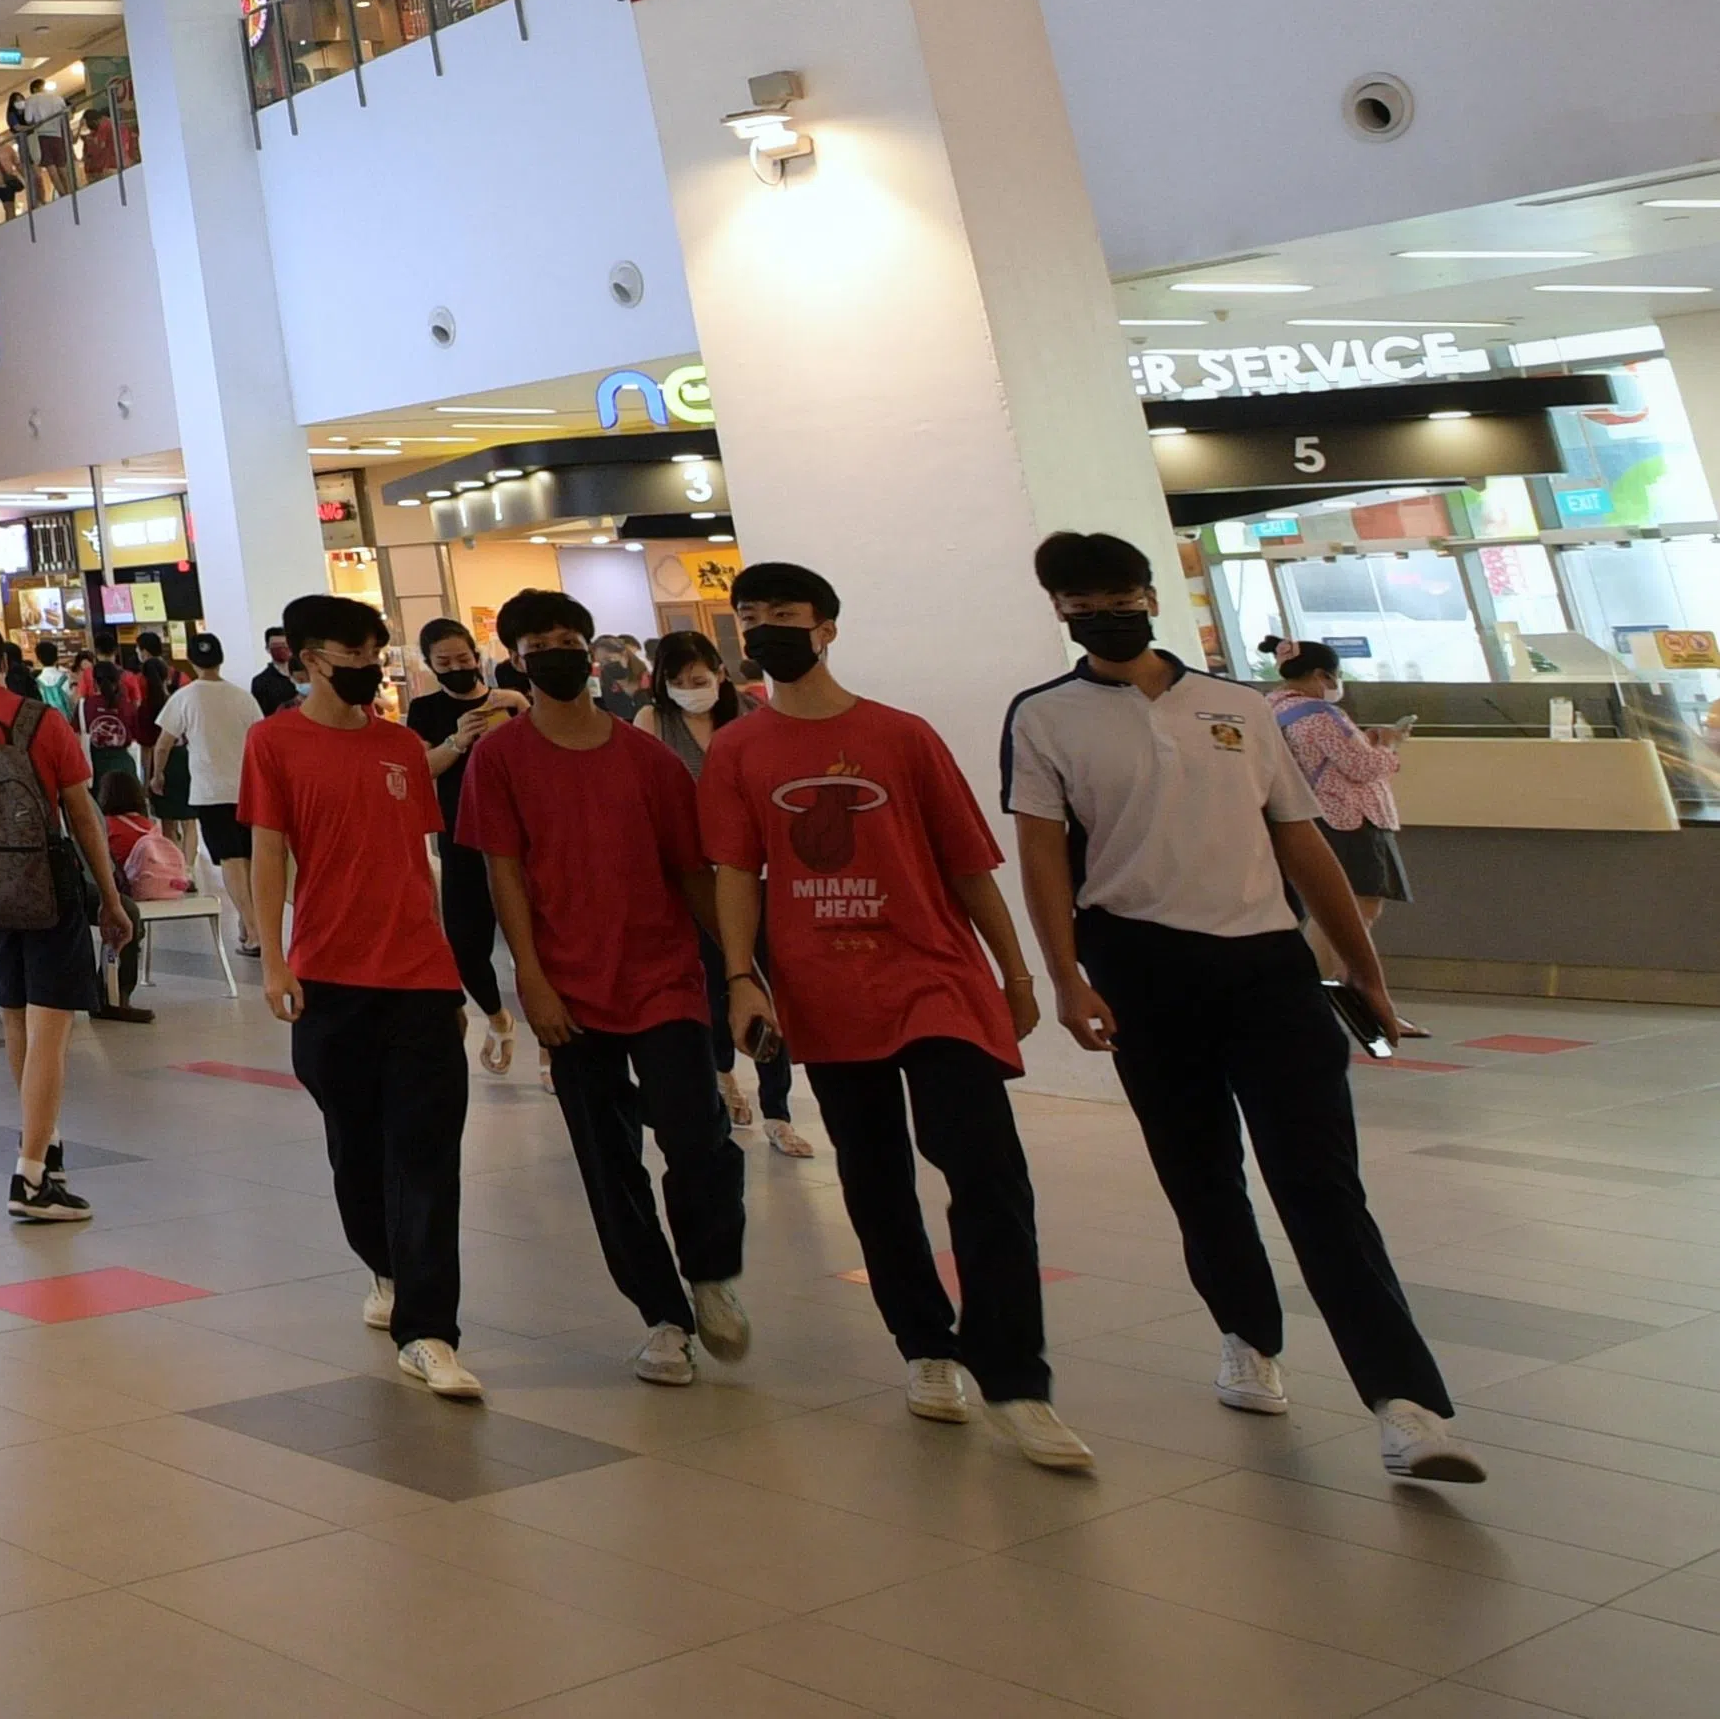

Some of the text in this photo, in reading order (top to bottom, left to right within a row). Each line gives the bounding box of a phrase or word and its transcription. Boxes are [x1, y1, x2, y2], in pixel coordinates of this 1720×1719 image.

[1198, 331, 1459, 392] SERVICE
[595, 365, 715, 429] ne
[1293, 436, 1327, 473] 5
[682, 468, 713, 503] 3
[1566, 493, 1602, 512] EXIT
[792, 878, 878, 898] MIAMI
[814, 895, 888, 918] HEAT
